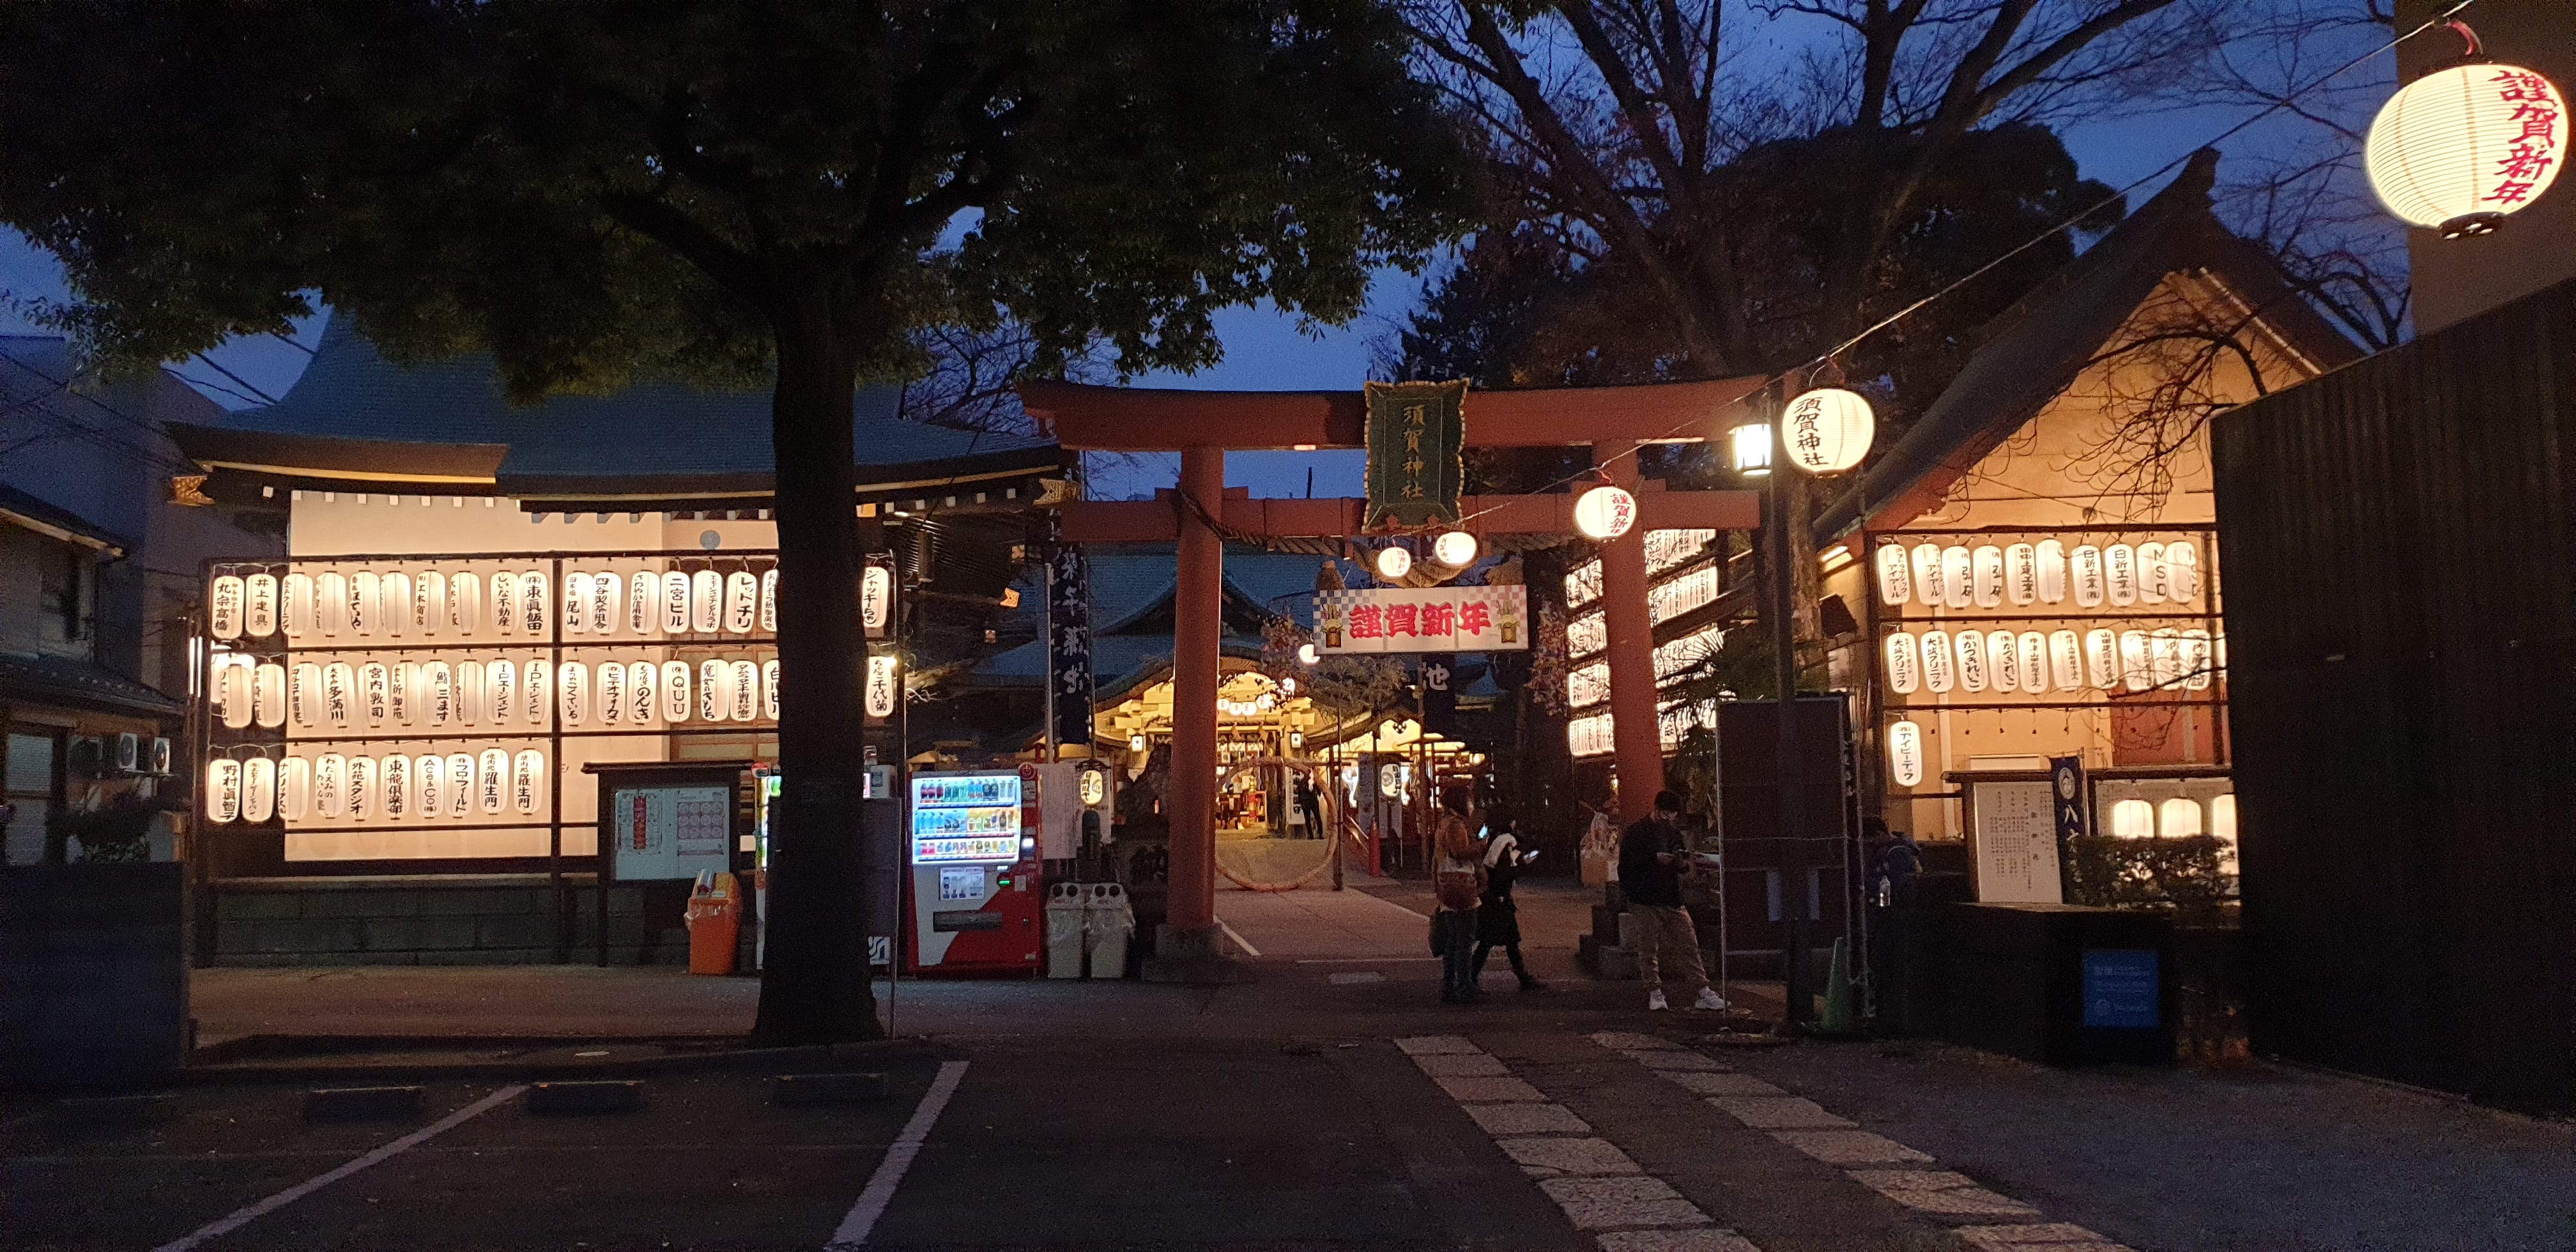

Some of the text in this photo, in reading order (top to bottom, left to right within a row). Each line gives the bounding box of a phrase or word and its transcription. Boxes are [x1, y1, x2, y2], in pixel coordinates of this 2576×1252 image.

[2481, 70, 2559, 204] 謹賀新年
[1400, 404, 1425, 500] 須賀神社
[1793, 397, 1829, 466] 須賀神社
[2153, 549, 2168, 597] MSD
[565, 600, 580, 627] 尾山
[669, 577, 685, 627] 二宮ビル
[737, 576, 754, 628] レッドチリ
[1348, 600, 1492, 639] 謹賀新年
[328, 686, 344, 721] 多満川
[349, 762, 366, 814] 外苑スタジオ
